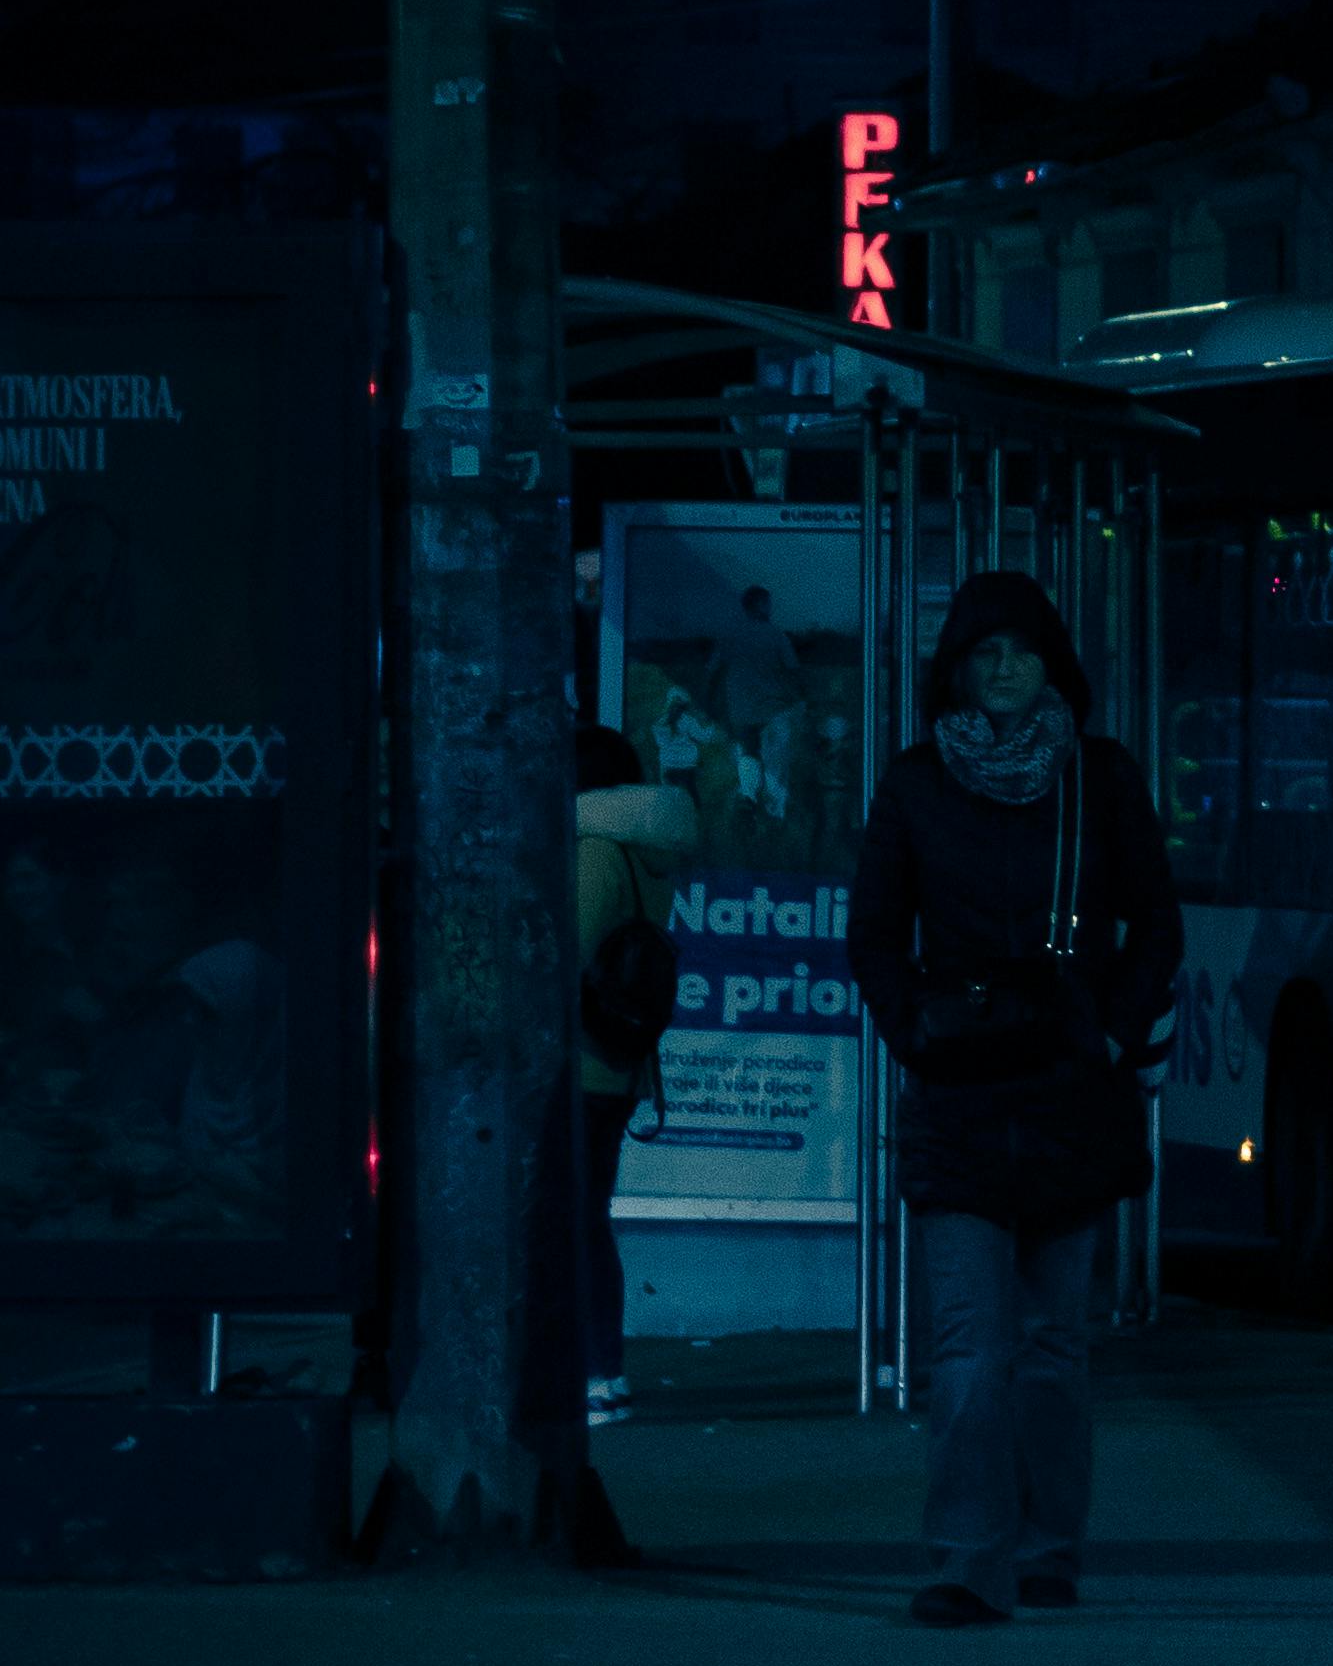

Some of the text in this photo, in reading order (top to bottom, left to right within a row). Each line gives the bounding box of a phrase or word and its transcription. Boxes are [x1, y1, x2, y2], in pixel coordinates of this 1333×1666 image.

[0, 373, 184, 425] TMOSFERA,
[0, 426, 87, 472] MUNI
[667, 882, 850, 940] Natali
[675, 972, 711, 1010] e
[659, 1048, 739, 1072] druženje
[662, 1076, 700, 1093] roje
